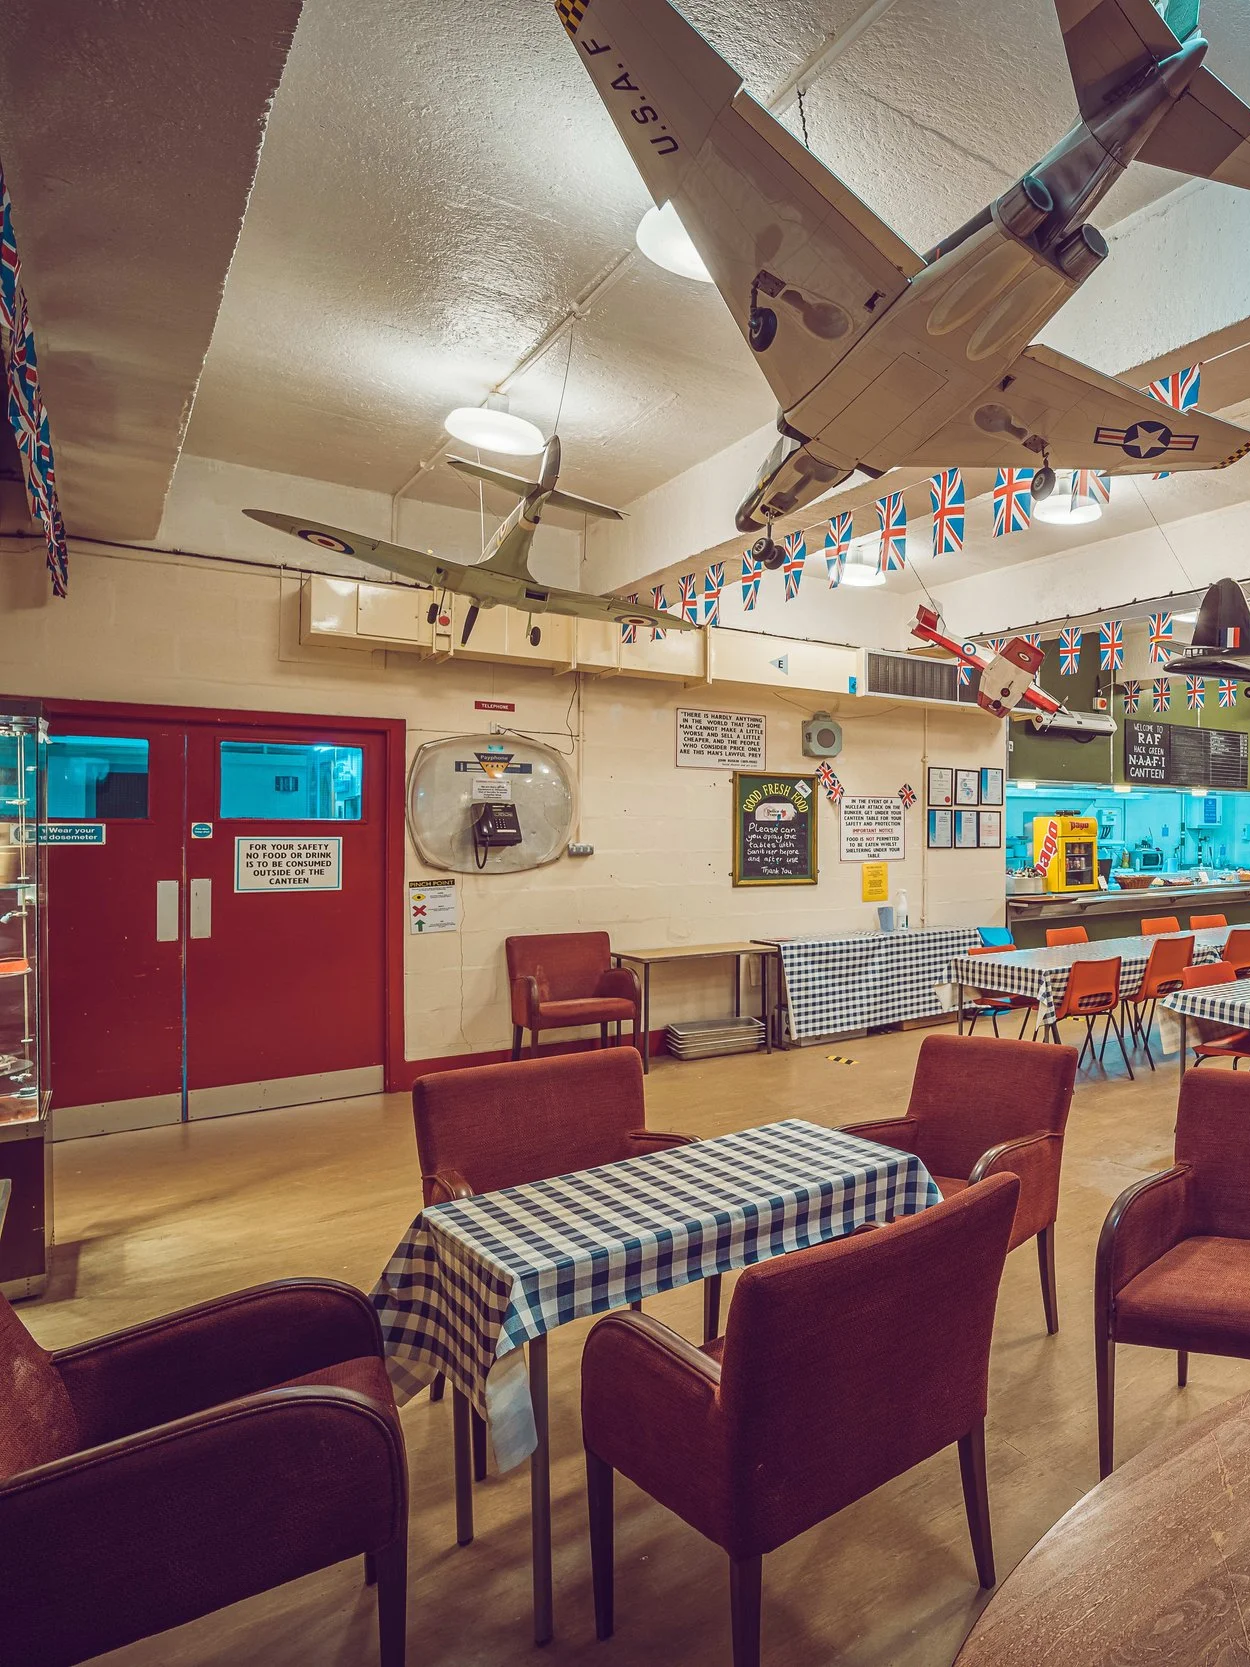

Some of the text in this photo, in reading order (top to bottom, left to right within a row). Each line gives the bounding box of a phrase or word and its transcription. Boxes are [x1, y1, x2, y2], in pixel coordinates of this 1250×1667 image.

[778, 660, 784, 669] E
[1133, 723, 1153, 732] WELCOME
[1138, 732, 1161, 745] RAF
[1149, 747, 1164, 755] GREEN
[1129, 767, 1164, 779] CANTEEN
[743, 790, 762, 811] GOOD
[762, 783, 791, 796] FRESH
[791, 791, 808, 812] FOOD
[749, 822, 778, 832] Please
[746, 834, 761, 842] you
[763, 834, 782, 843] spray
[780, 848, 799, 856] before
[761, 866, 780, 874] Thank
[269, 877, 309, 885] CANTEEN
